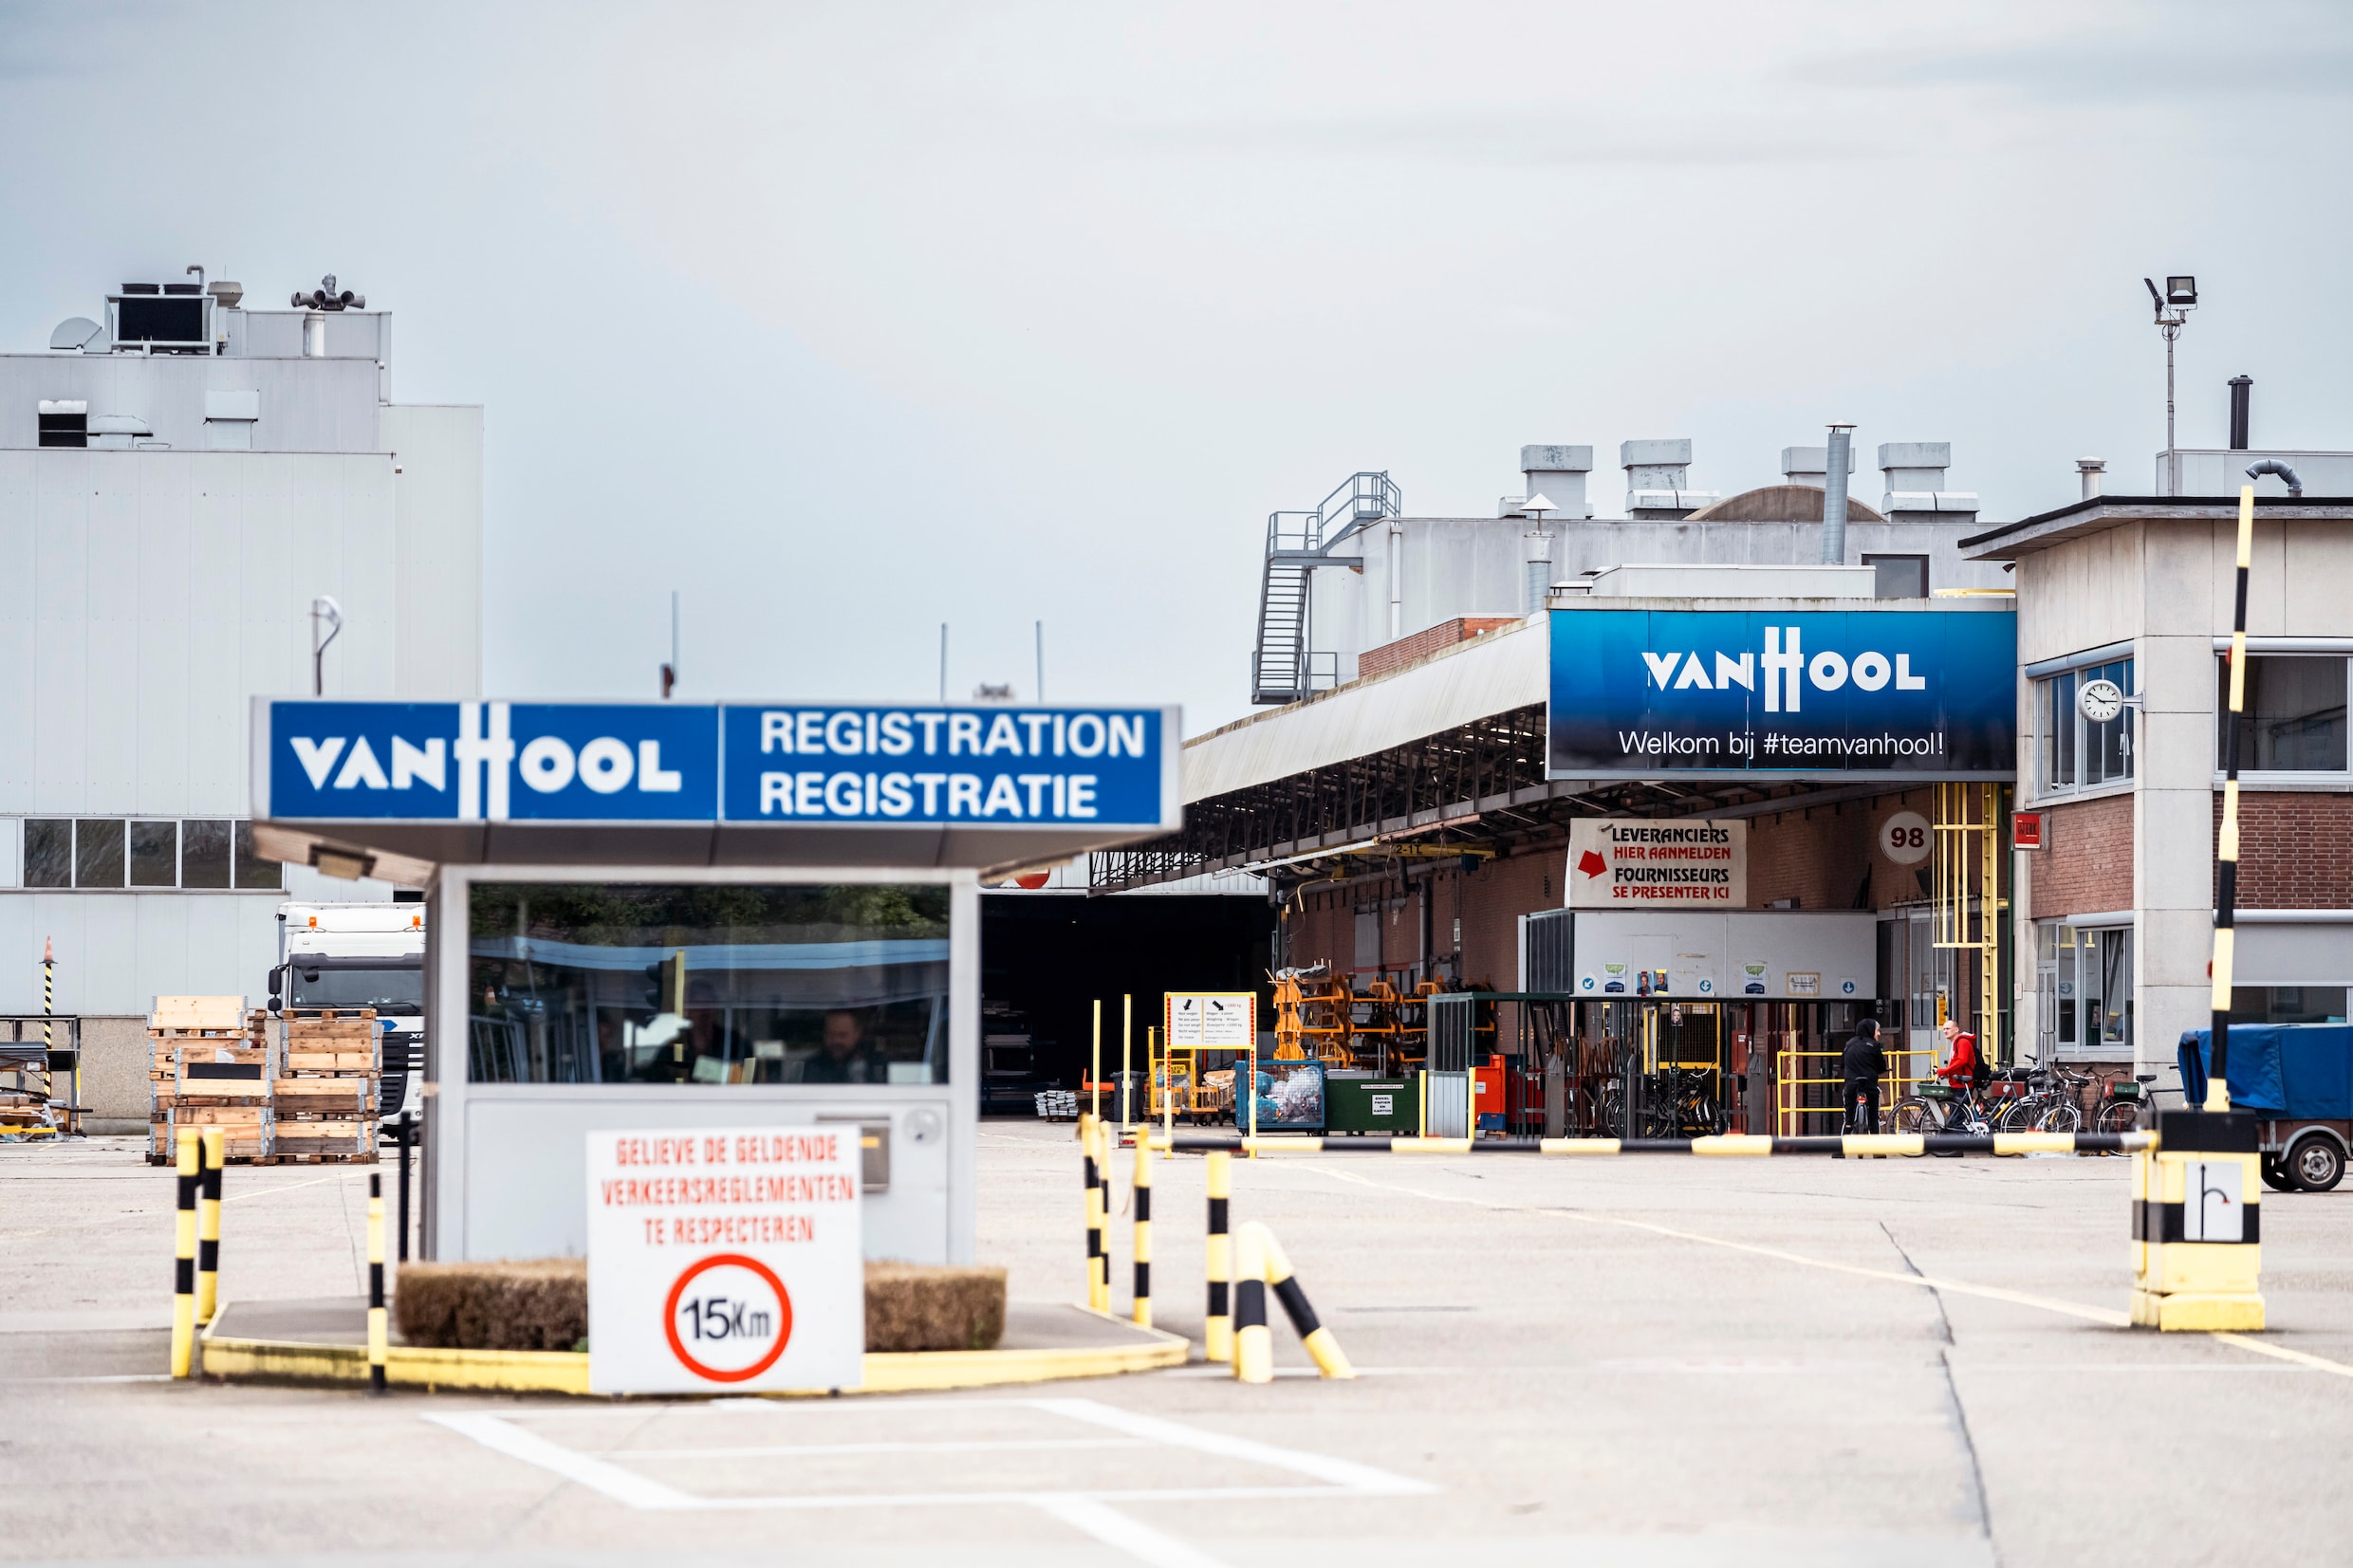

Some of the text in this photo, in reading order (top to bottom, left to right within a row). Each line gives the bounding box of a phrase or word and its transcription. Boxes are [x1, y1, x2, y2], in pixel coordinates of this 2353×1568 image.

[761, 710, 1146, 758] REGISTRATION
[1619, 730, 1944, 760] Welkom bij #teamvanhool!
[760, 771, 1098, 819] REGISTRATIE
[1612, 828, 1730, 844] LEVERANCIERS
[1891, 827, 1925, 848] 98
[1614, 846, 1732, 860] HIER AANMELDEN
[1615, 867, 1730, 884] FOURNISSEURS
[1612, 886, 1730, 900] SE PRESENTER ICI
[617, 1134, 837, 1167] GELIEVE DE GELDENDE
[602, 1175, 854, 1206] VERKEERSREGLEMENTEN
[644, 1216, 814, 1245] TE RESPECTEREN
